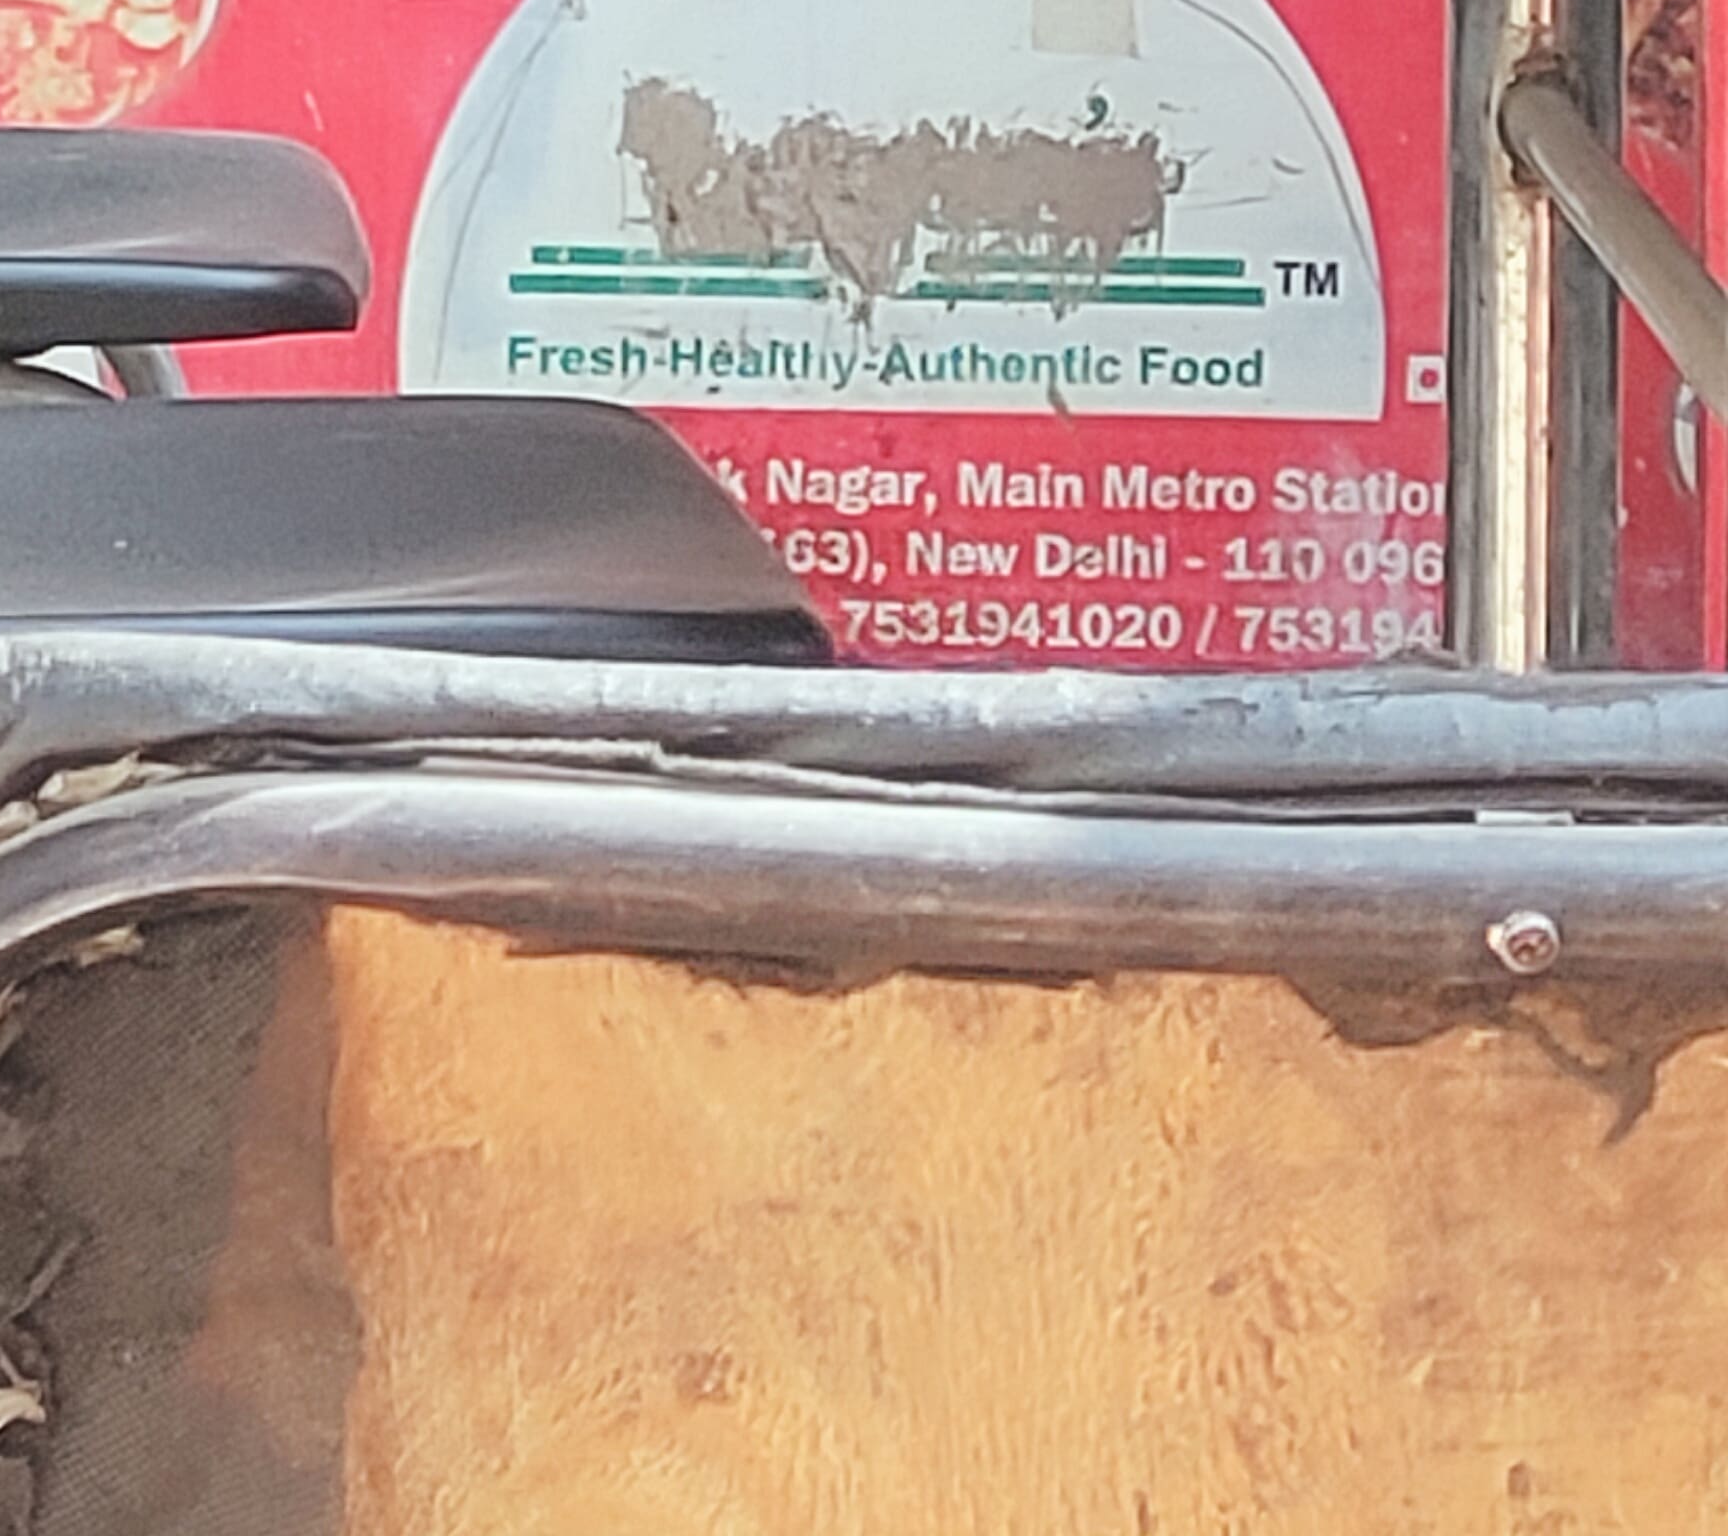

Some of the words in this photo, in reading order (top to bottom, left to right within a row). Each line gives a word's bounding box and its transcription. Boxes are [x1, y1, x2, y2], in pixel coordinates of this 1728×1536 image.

[1274, 261, 1340, 298] TM
[1139, 346, 1265, 387] Food
[765, 459, 938, 516] Nagar,
[958, 463, 1084, 508] Main
[1103, 467, 1257, 511] Metro
[907, 533, 1018, 576] New
[1035, 535, 1168, 580] Delhi
[1223, 538, 1325, 582] 110
[1343, 538, 1444, 584] 096
[840, 599, 1183, 650] 7531941020
